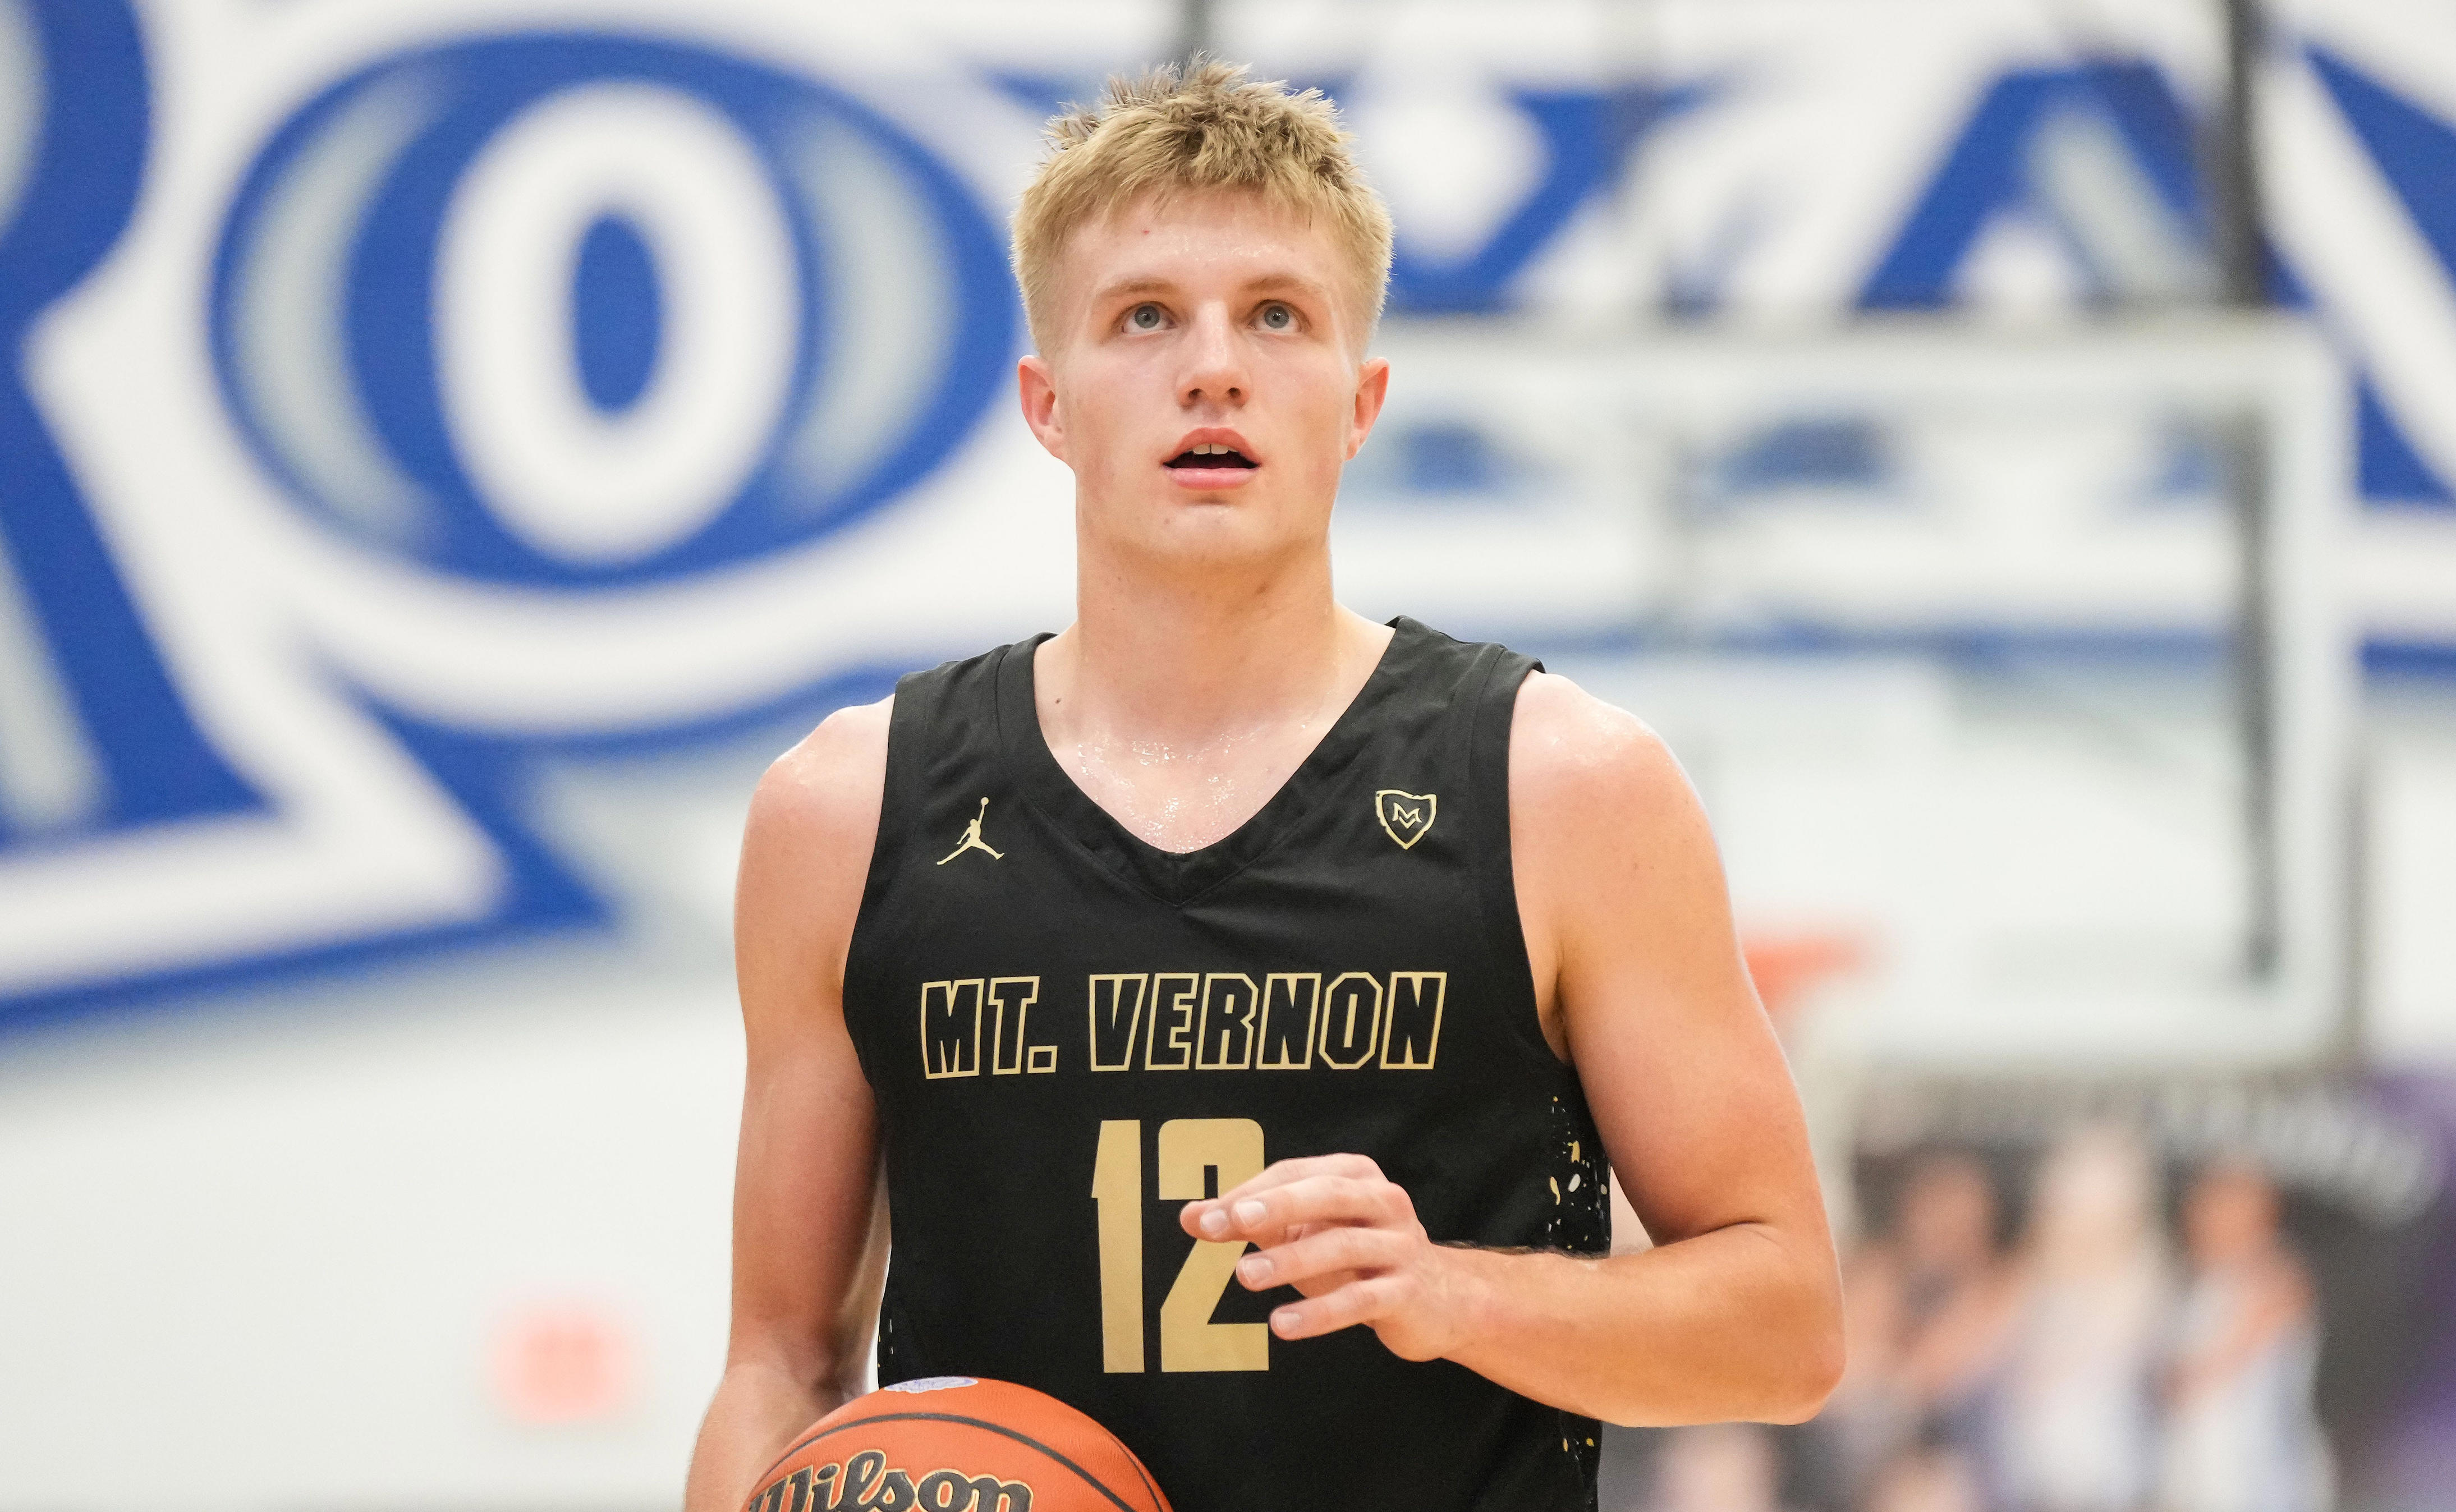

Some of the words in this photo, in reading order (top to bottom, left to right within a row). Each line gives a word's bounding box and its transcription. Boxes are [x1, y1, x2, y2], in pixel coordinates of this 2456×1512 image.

[921, 976, 1058, 1079] MT.
[1089, 972, 1447, 1072] VERNON
[1091, 1118, 1269, 1373] 12
